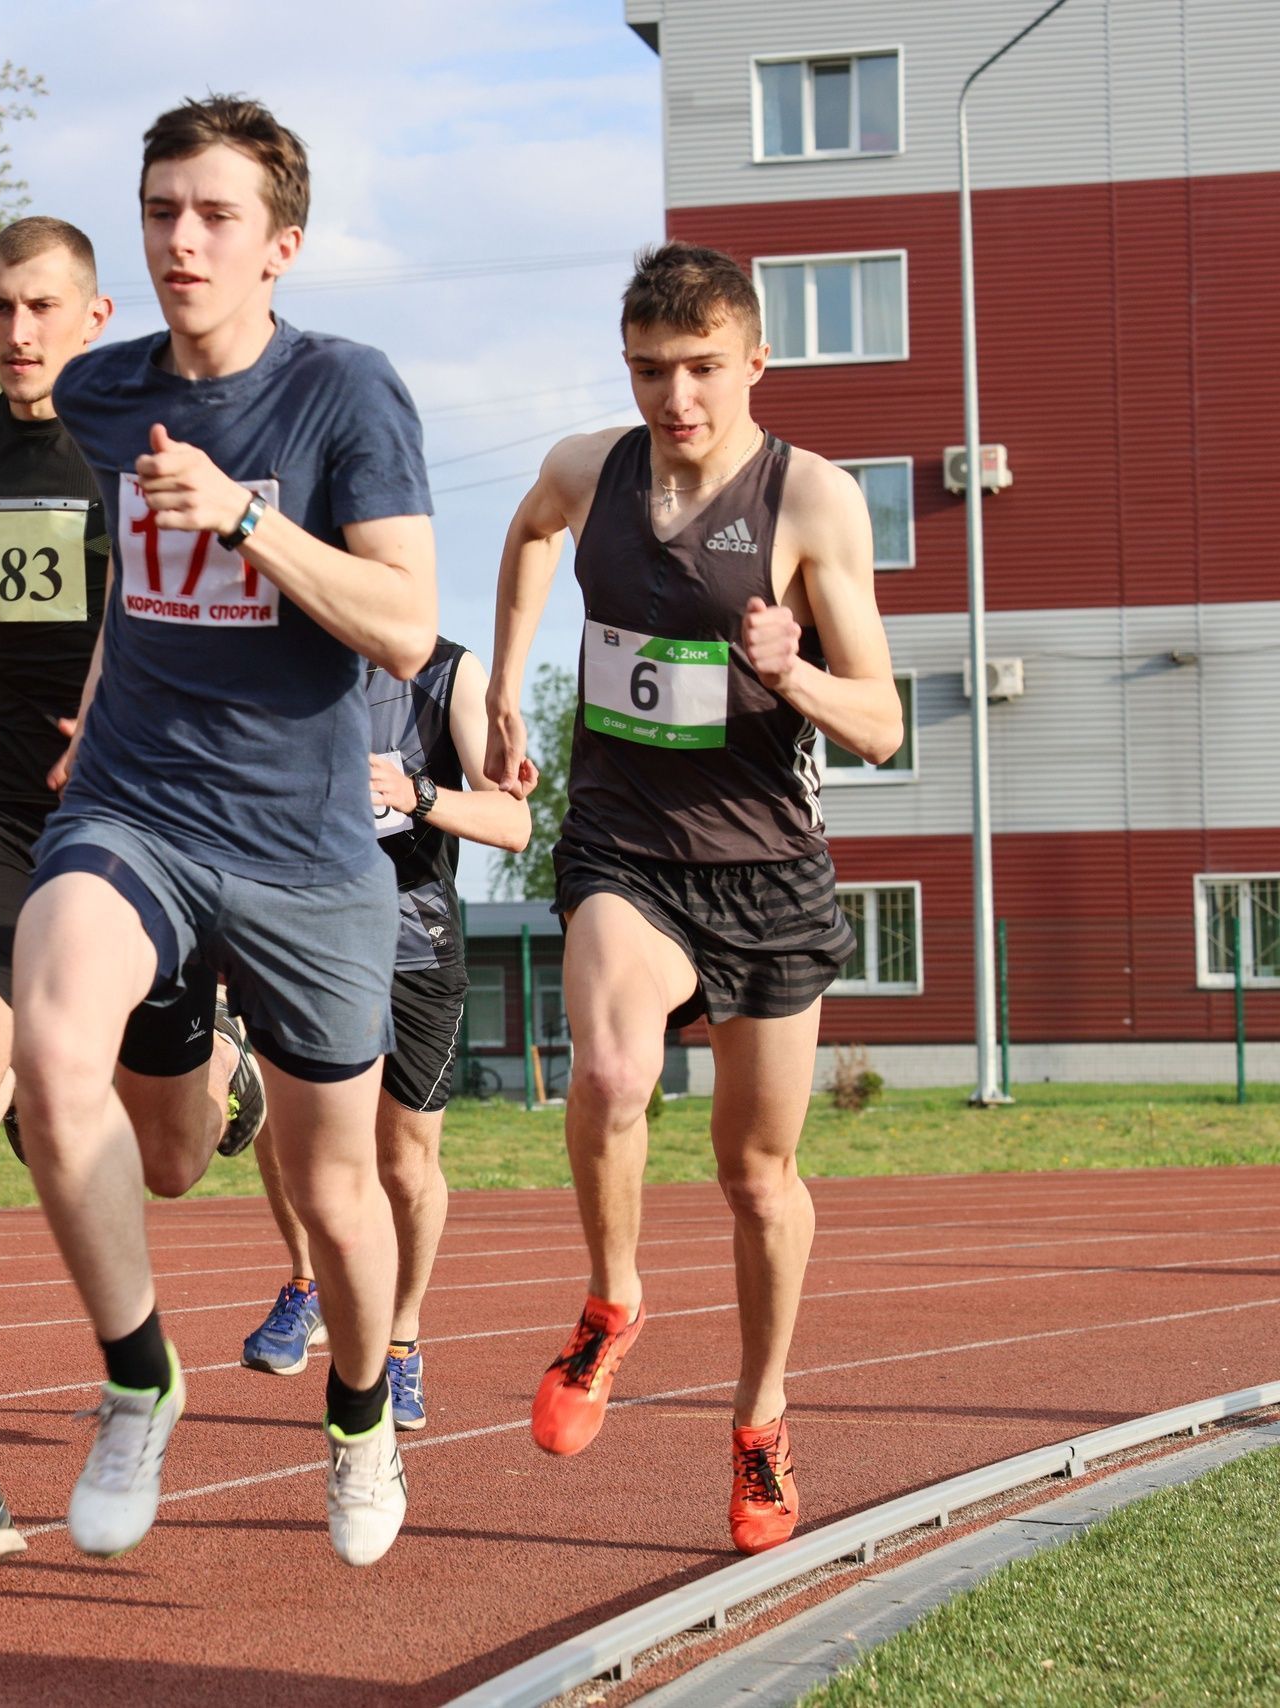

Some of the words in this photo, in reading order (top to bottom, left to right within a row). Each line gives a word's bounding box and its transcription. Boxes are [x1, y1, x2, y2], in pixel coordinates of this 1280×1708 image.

[706, 538, 758, 554] adidas
[126, 594, 200, 620] КОРОЛЕВА
[209, 604, 272, 621] СПОРТА
[629, 661, 660, 712] 6
